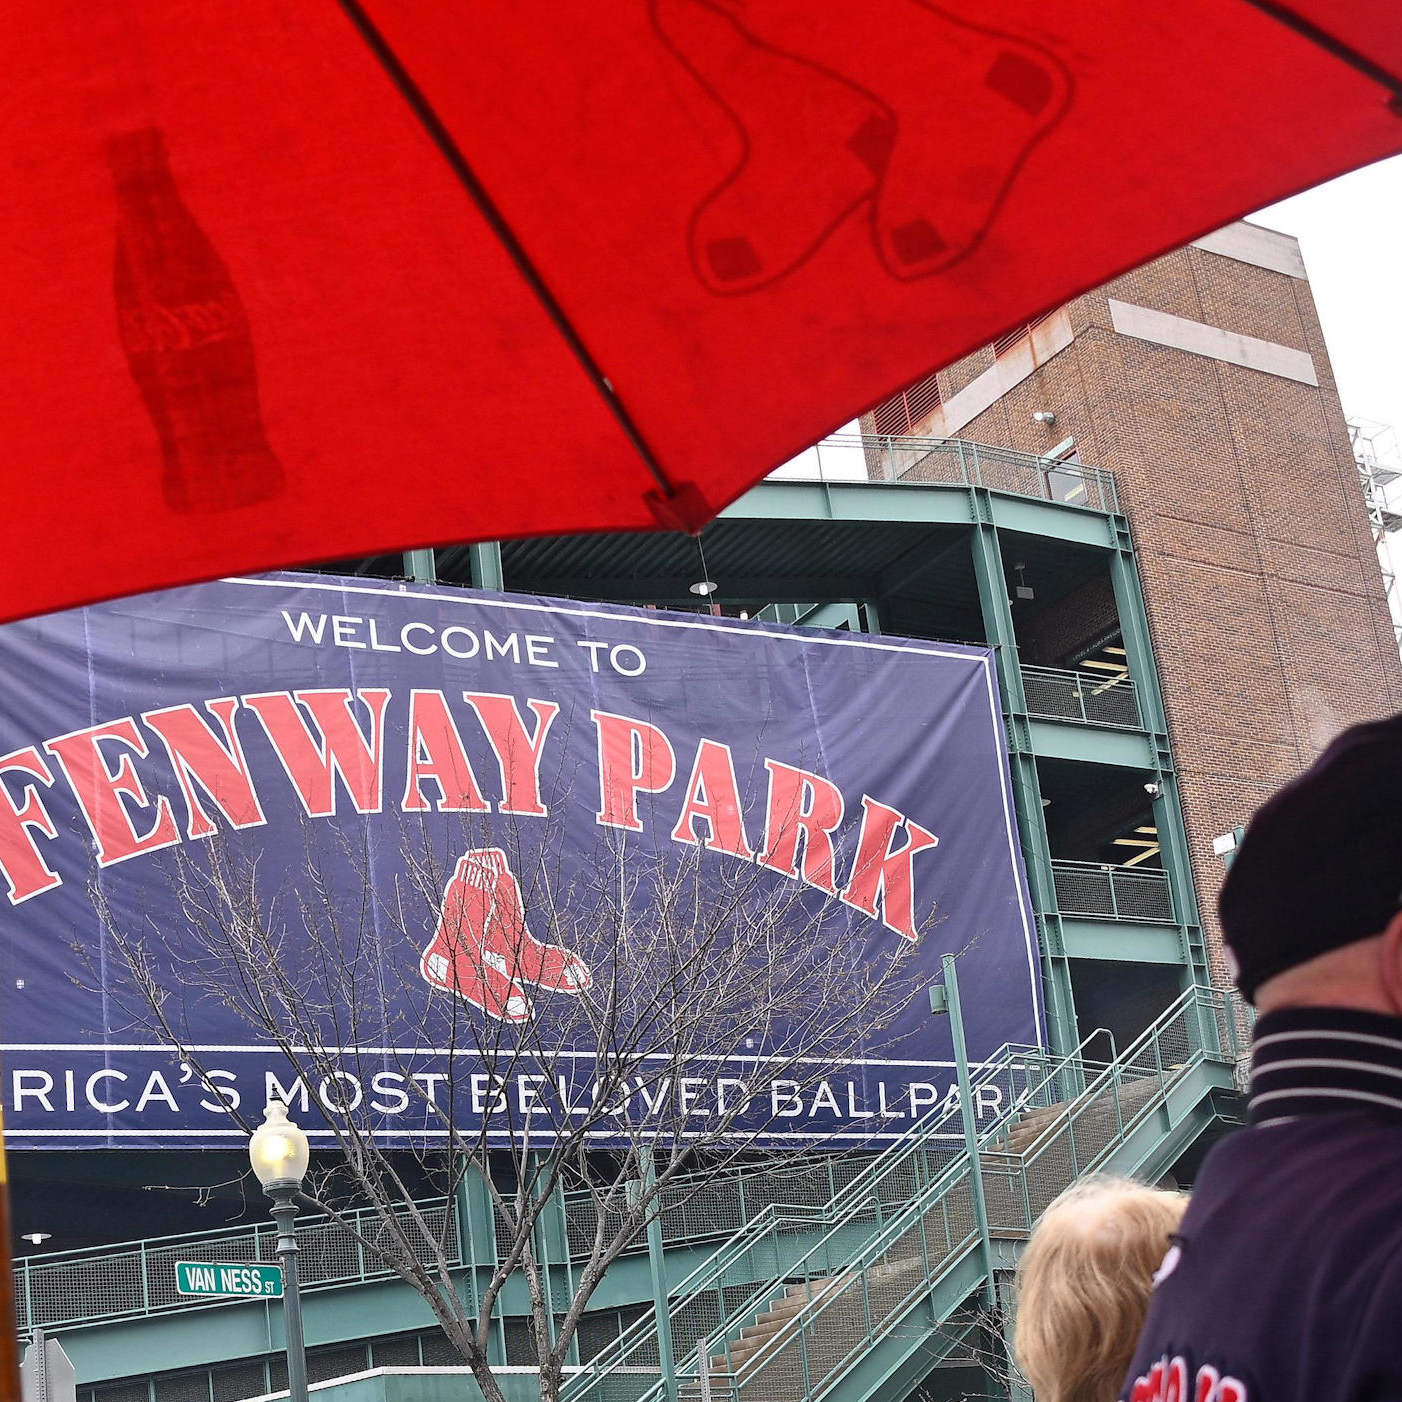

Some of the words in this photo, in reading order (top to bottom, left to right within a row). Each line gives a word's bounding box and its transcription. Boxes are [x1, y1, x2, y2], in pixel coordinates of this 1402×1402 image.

[281, 609, 560, 669] WELCOME
[577, 639, 648, 677] TO
[590, 708, 939, 941] PARK
[264, 1070, 452, 1115] MOST
[472, 1072, 752, 1118] BELOVED
[185, 1267, 216, 1292] VAN
[220, 1268, 263, 1294] NESS
[264, 1281, 275, 1294] ST
